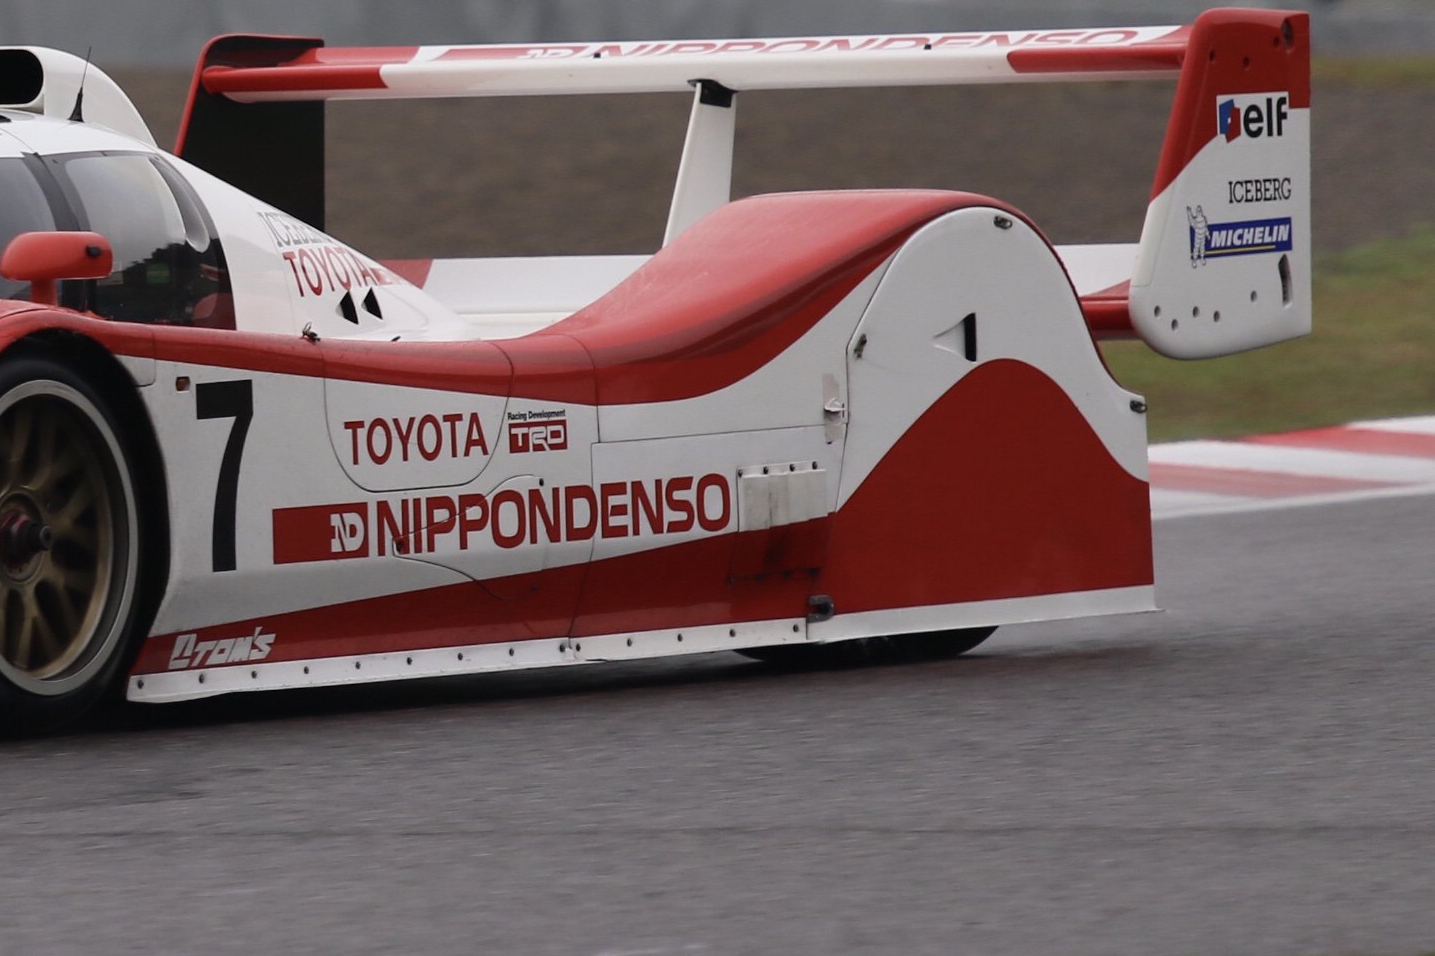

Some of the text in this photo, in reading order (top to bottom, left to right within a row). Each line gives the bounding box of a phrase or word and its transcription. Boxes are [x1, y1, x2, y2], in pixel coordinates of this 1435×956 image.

[588, 30, 1140, 58] NIPPONDENSO
[1243, 96, 1288, 139] elf
[1228, 177, 1292, 204] ICEBERG
[1211, 224, 1290, 248] MICHELIN
[282, 246, 379, 298] TOYOTA
[507, 408, 566, 421] Racing Development
[344, 412, 489, 466] TOYOTA
[510, 424, 566, 452] TRD
[196, 379, 254, 573] 7
[376, 472, 732, 557] NIPPONDENSO
